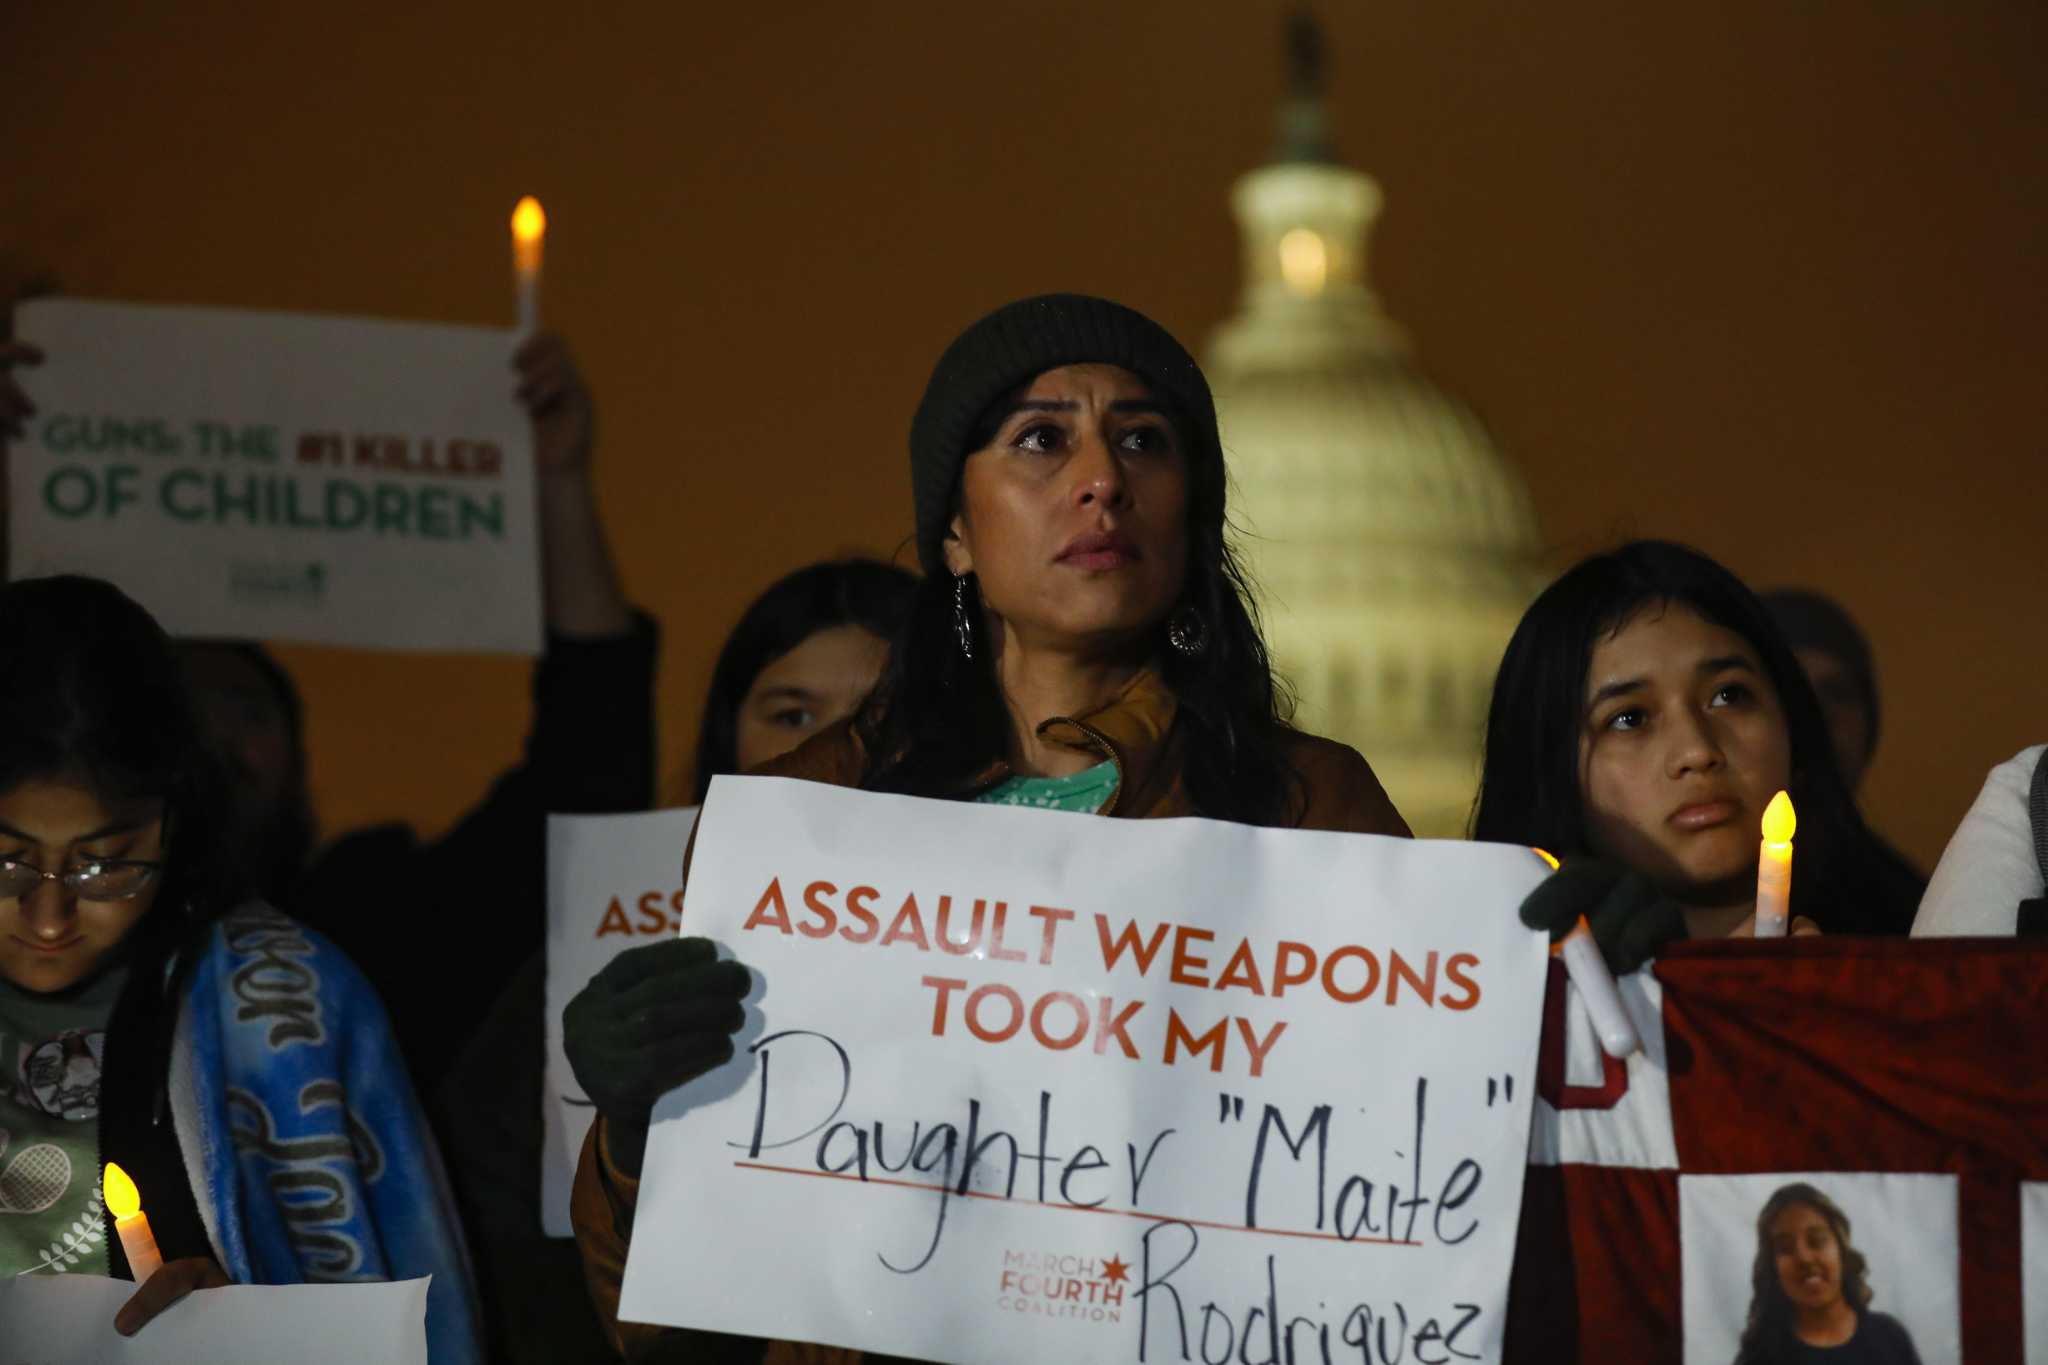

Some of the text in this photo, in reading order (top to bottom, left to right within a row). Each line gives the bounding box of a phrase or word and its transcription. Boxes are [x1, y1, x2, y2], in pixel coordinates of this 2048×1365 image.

[194, 421, 277, 461] THE
[296, 430, 344, 465] #1
[353, 432, 502, 477] KILLER
[43, 464, 507, 540] OF CHILDREN
[743, 876, 1482, 1011] ASSAULT WEAPONS
[922, 975, 1289, 1078] TOOK MY
[727, 1030, 1177, 1275] Daughter
[998, 1296, 1121, 1324] COALITION
[1001, 1270, 1124, 1307] FOURTH
